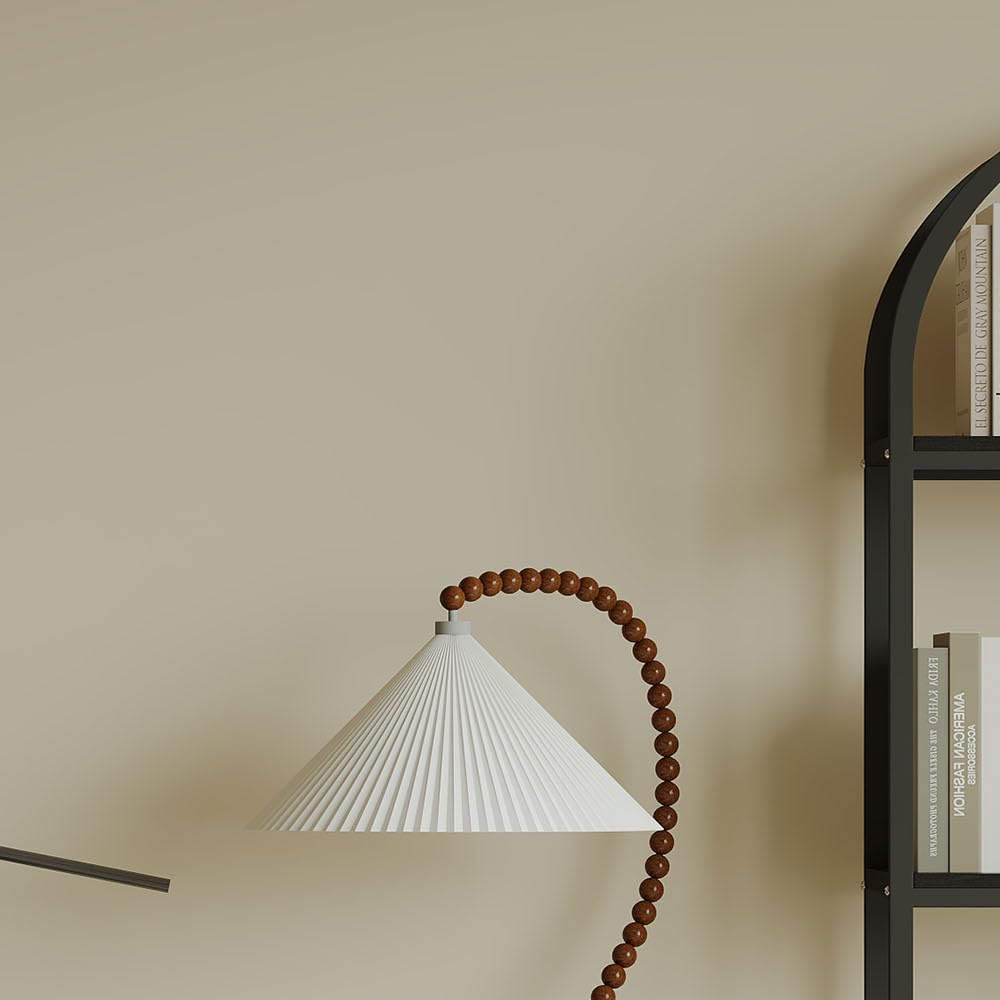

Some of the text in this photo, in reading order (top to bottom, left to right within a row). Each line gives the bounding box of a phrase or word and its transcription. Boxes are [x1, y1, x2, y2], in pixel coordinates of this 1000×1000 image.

[975, 238, 988, 429] EL SECRETO DE GRAY MOUNTAIN
